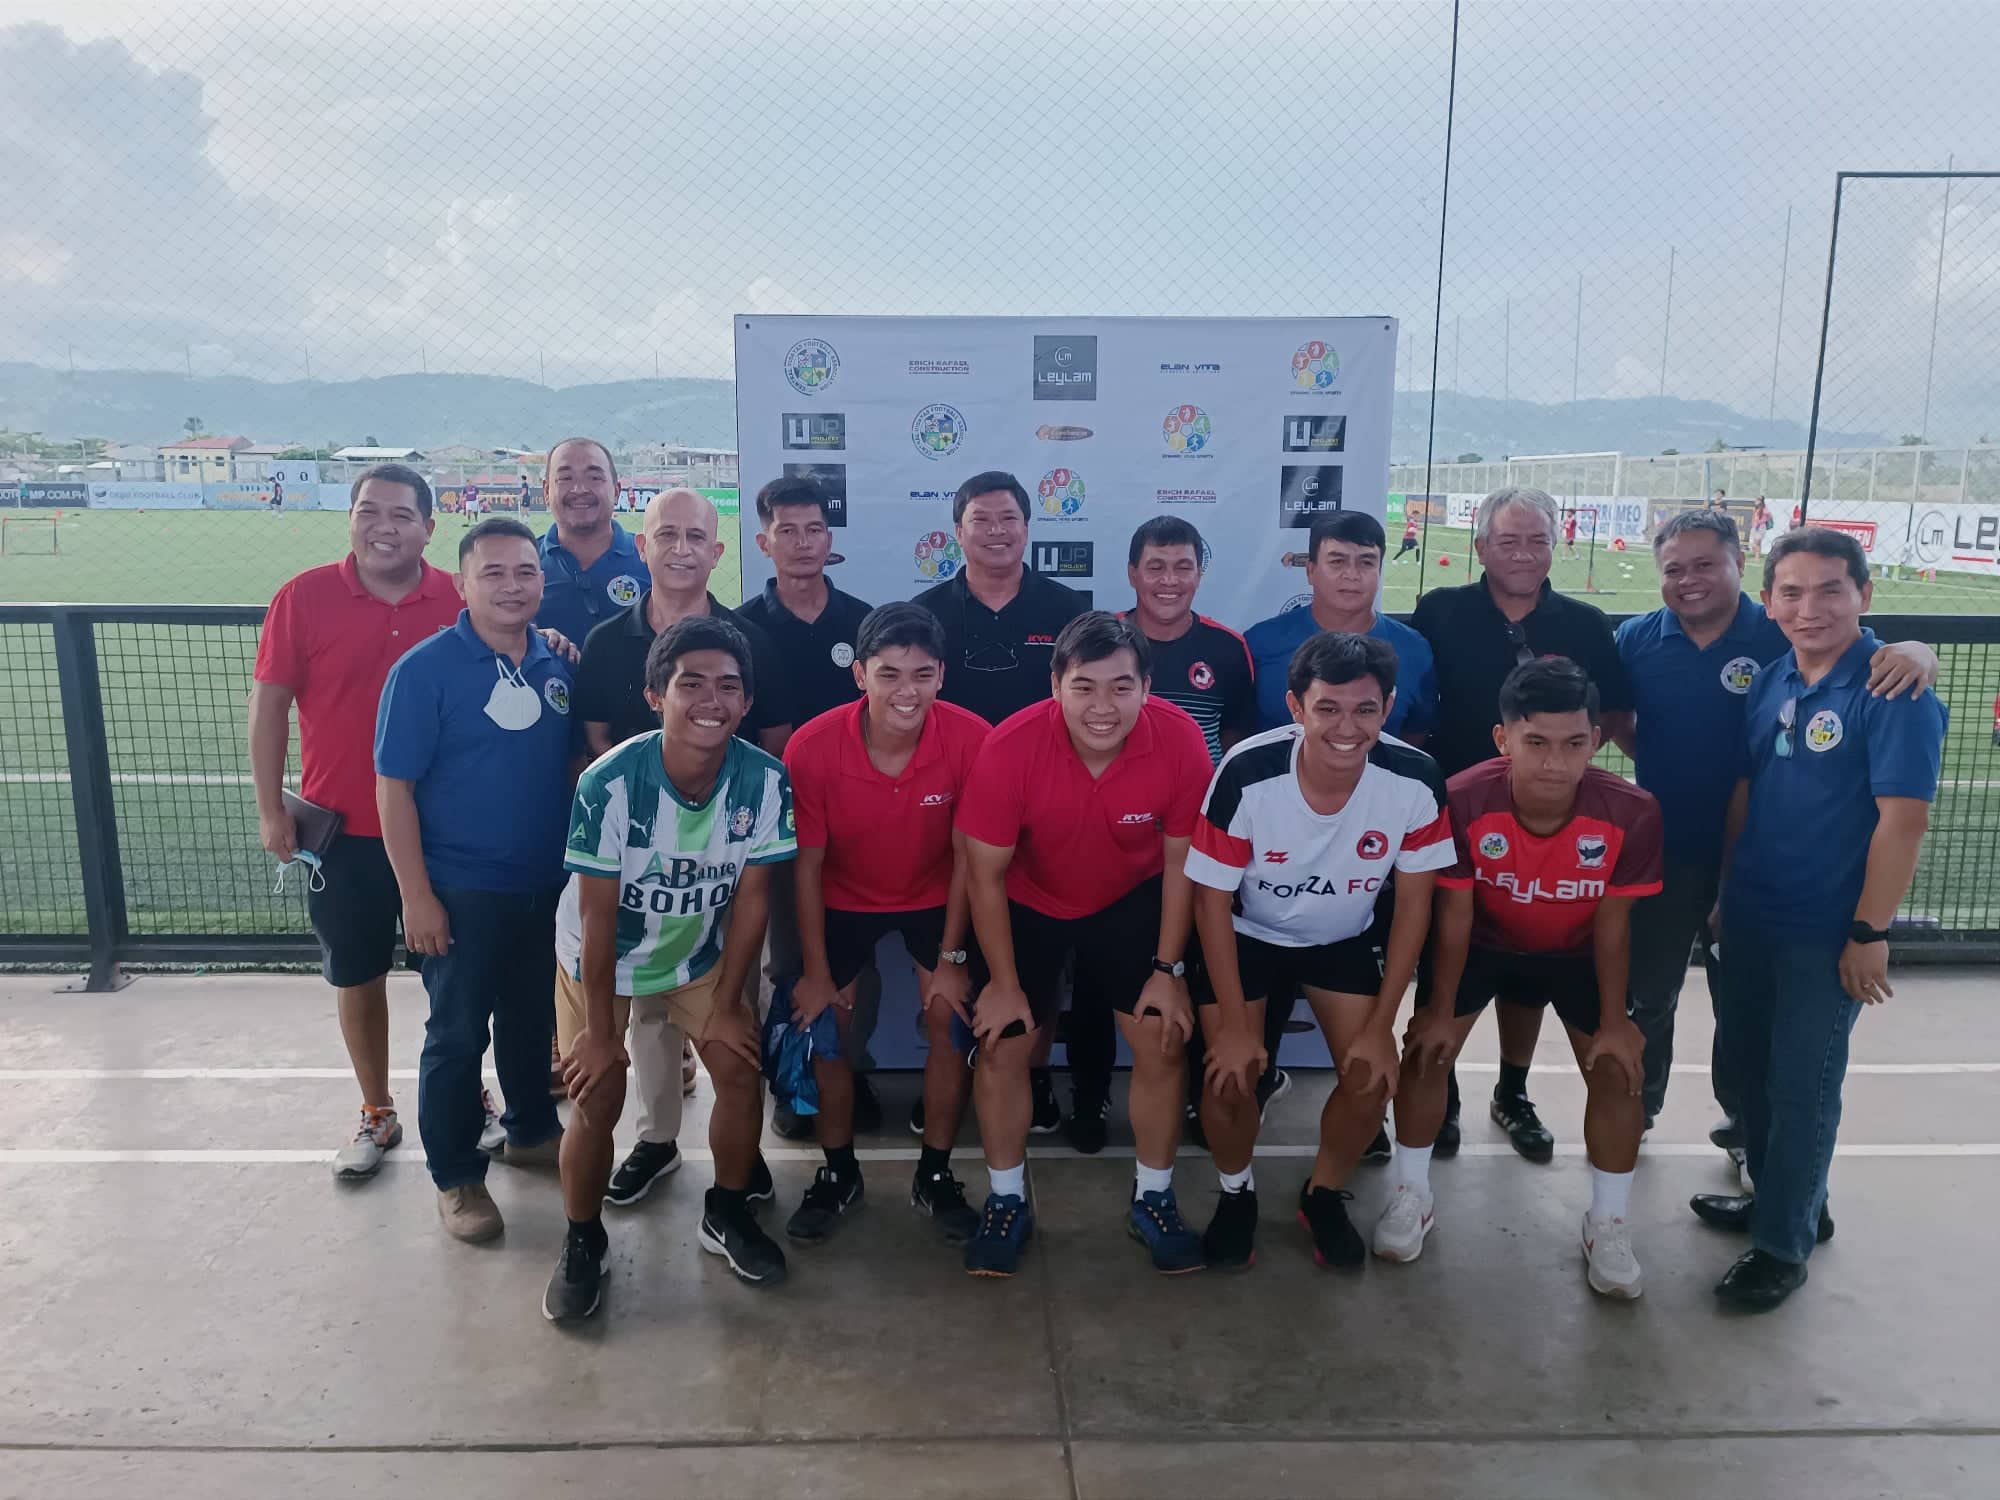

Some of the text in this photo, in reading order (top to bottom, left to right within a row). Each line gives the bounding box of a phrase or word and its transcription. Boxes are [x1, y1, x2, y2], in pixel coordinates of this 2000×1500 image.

[277, 471, 309, 481] 0 0
[1258, 875, 1381, 898] FORZA FC
